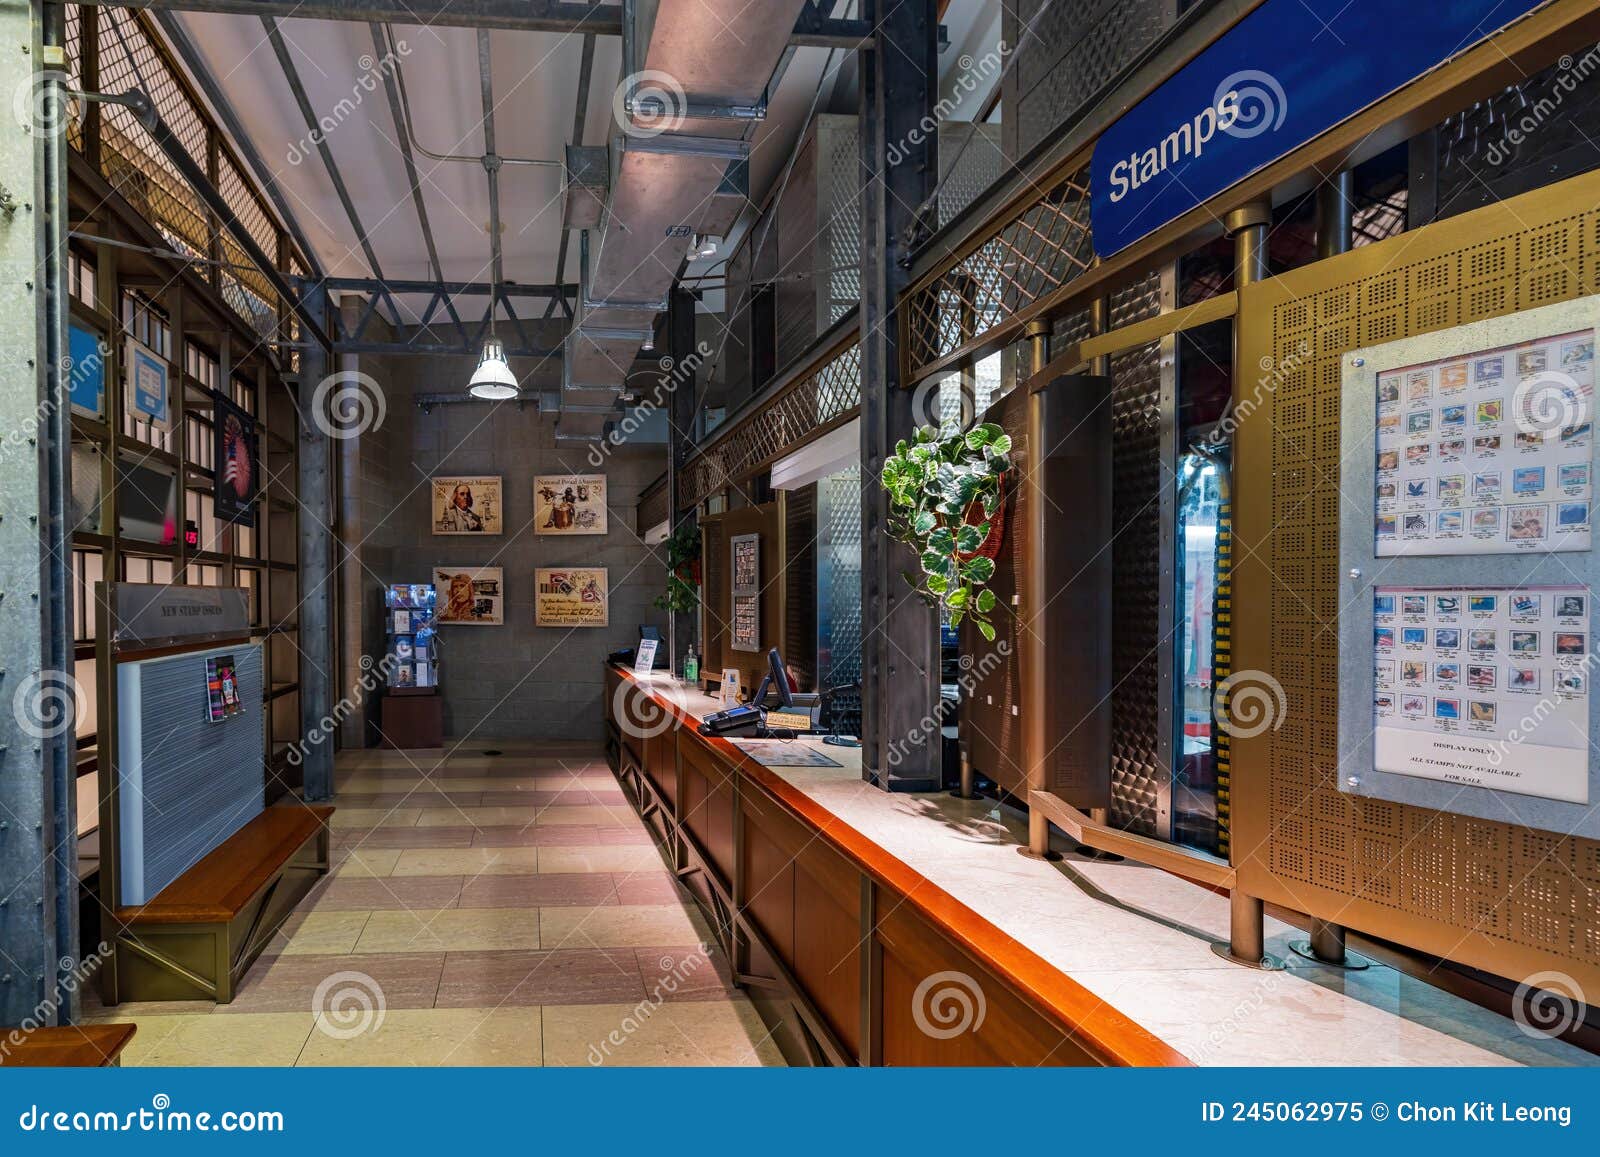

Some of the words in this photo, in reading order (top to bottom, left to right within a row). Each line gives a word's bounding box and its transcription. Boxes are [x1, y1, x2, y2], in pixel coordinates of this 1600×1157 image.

[1109, 90, 1239, 203] Stamps
[1433, 742, 1467, 752] DISPLAY
[1425, 759, 1455, 768] STAMPS
[1456, 763, 1473, 771] NOT
[1474, 766, 1522, 778] AVAILABLE
[1461, 776, 1482, 784] SALE
